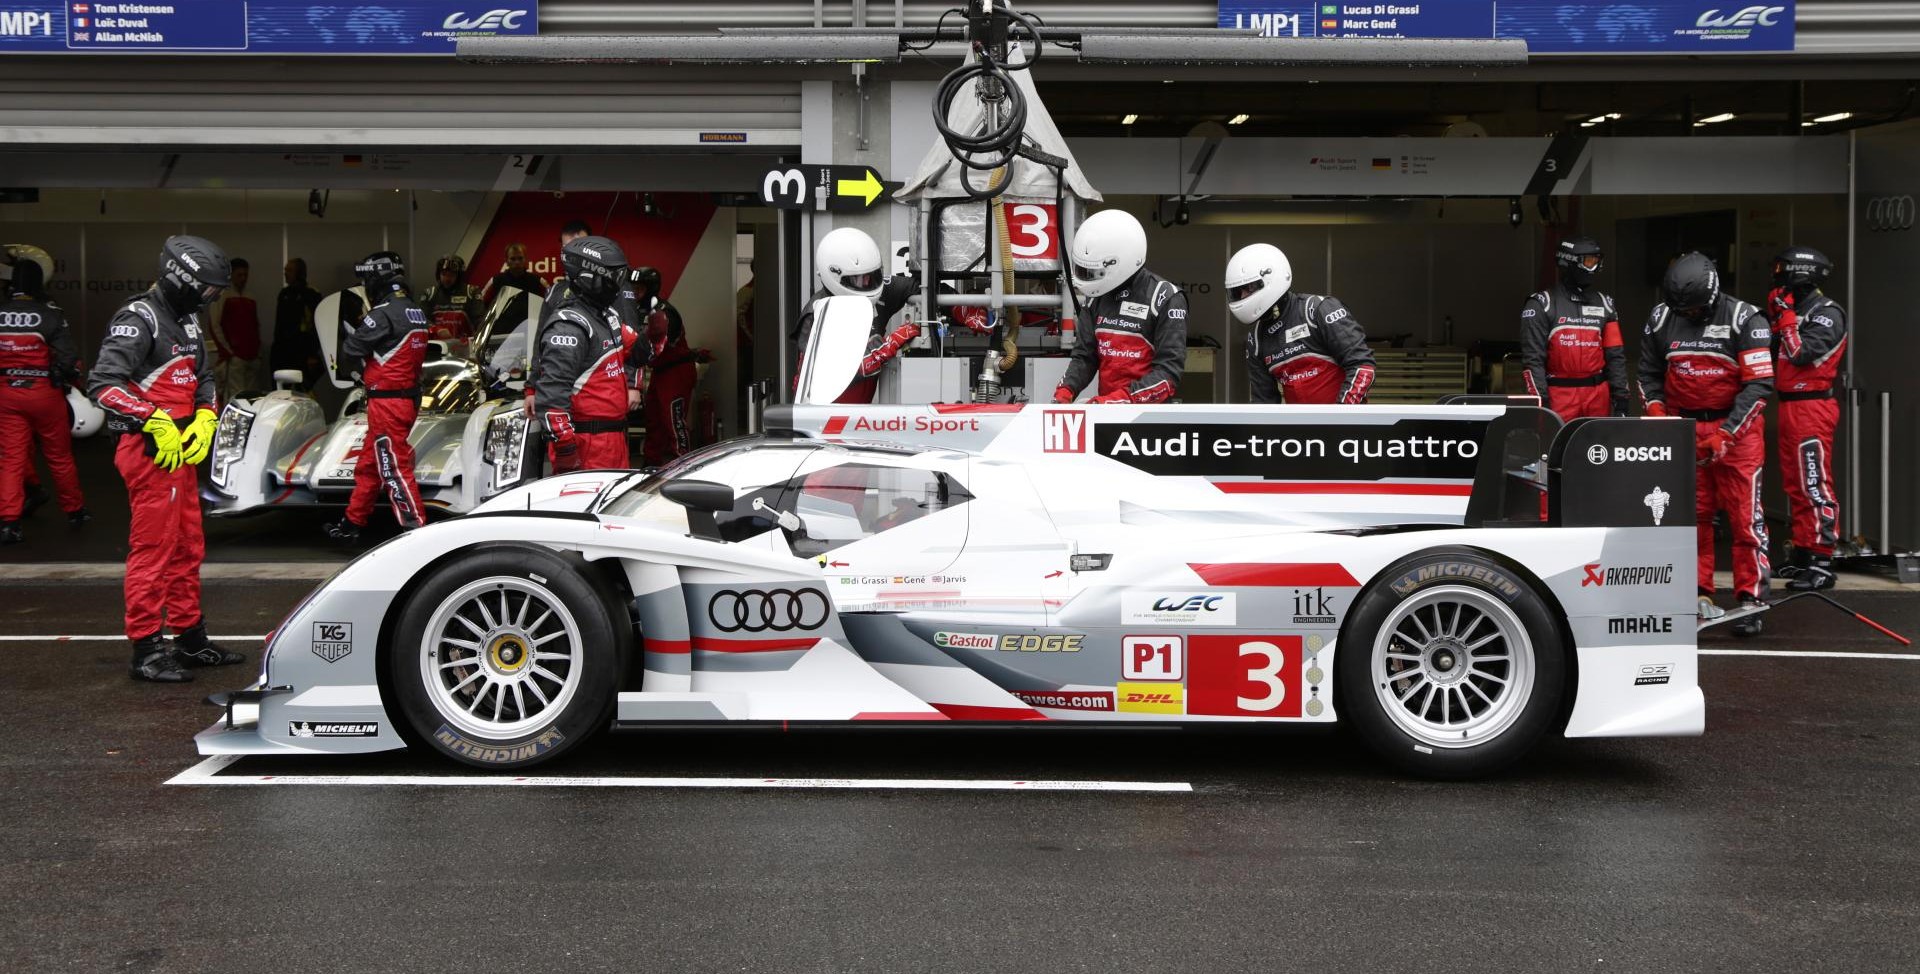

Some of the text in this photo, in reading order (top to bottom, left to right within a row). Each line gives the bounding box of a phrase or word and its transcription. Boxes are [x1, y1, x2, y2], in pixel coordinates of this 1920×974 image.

[95, 3, 174, 14] Tom Kristensen
[1343, 4, 1420, 15] Lucas Di Grassi
[1696, 5, 1785, 27] WEC
[0, 12, 51, 36] MP1
[95, 17, 148, 28] Loïc Duval
[443, 9, 528, 29] WEC
[1343, 18, 1398, 29] Marc Gené
[95, 31, 163, 42] Allan McNish
[513, 157, 525, 168] 2
[1544, 159, 1558, 173] 3
[764, 169, 806, 204] 3
[1010, 204, 1050, 257] 3
[583, 247, 602, 260] uvex
[181, 252, 201, 273] uvex
[581, 259, 614, 280] uvex
[1786, 264, 1817, 273] uvex
[166, 258, 201, 291] uvex
[1102, 317, 1142, 329] Audi Sport
[1566, 316, 1582, 324] Audi
[1559, 339, 1574, 347] Top
[1680, 340, 1723, 350] Audi Sport
[1107, 348, 1142, 359] Service
[1271, 343, 1307, 361] Audi Sport
[172, 375, 189, 385] Top
[1689, 367, 1724, 376] Service
[853, 416, 980, 435] Audi Sport
[1045, 412, 1085, 451] HY
[1110, 431, 1479, 464] Audi e-tron quattro
[1614, 447, 1672, 461] BOSCH
[1806, 450, 1820, 487] Sport
[851, 575, 967, 585] di Grassi Gené Jarvis
[1418, 563, 1517, 595] MICHELIN
[1152, 595, 1224, 613] WEC
[1292, 585, 1336, 616] itk
[319, 625, 346, 641] TAG
[1608, 616, 1672, 634] MAHLE
[315, 643, 350, 660] HEUER
[949, 633, 1087, 653] Castrol EDGE
[1133, 643, 1172, 673] P1
[1236, 641, 1287, 712] 3
[1127, 693, 1175, 704] DHL
[314, 725, 377, 733] MICHELIN
[436, 730, 538, 763] MICHELIN
